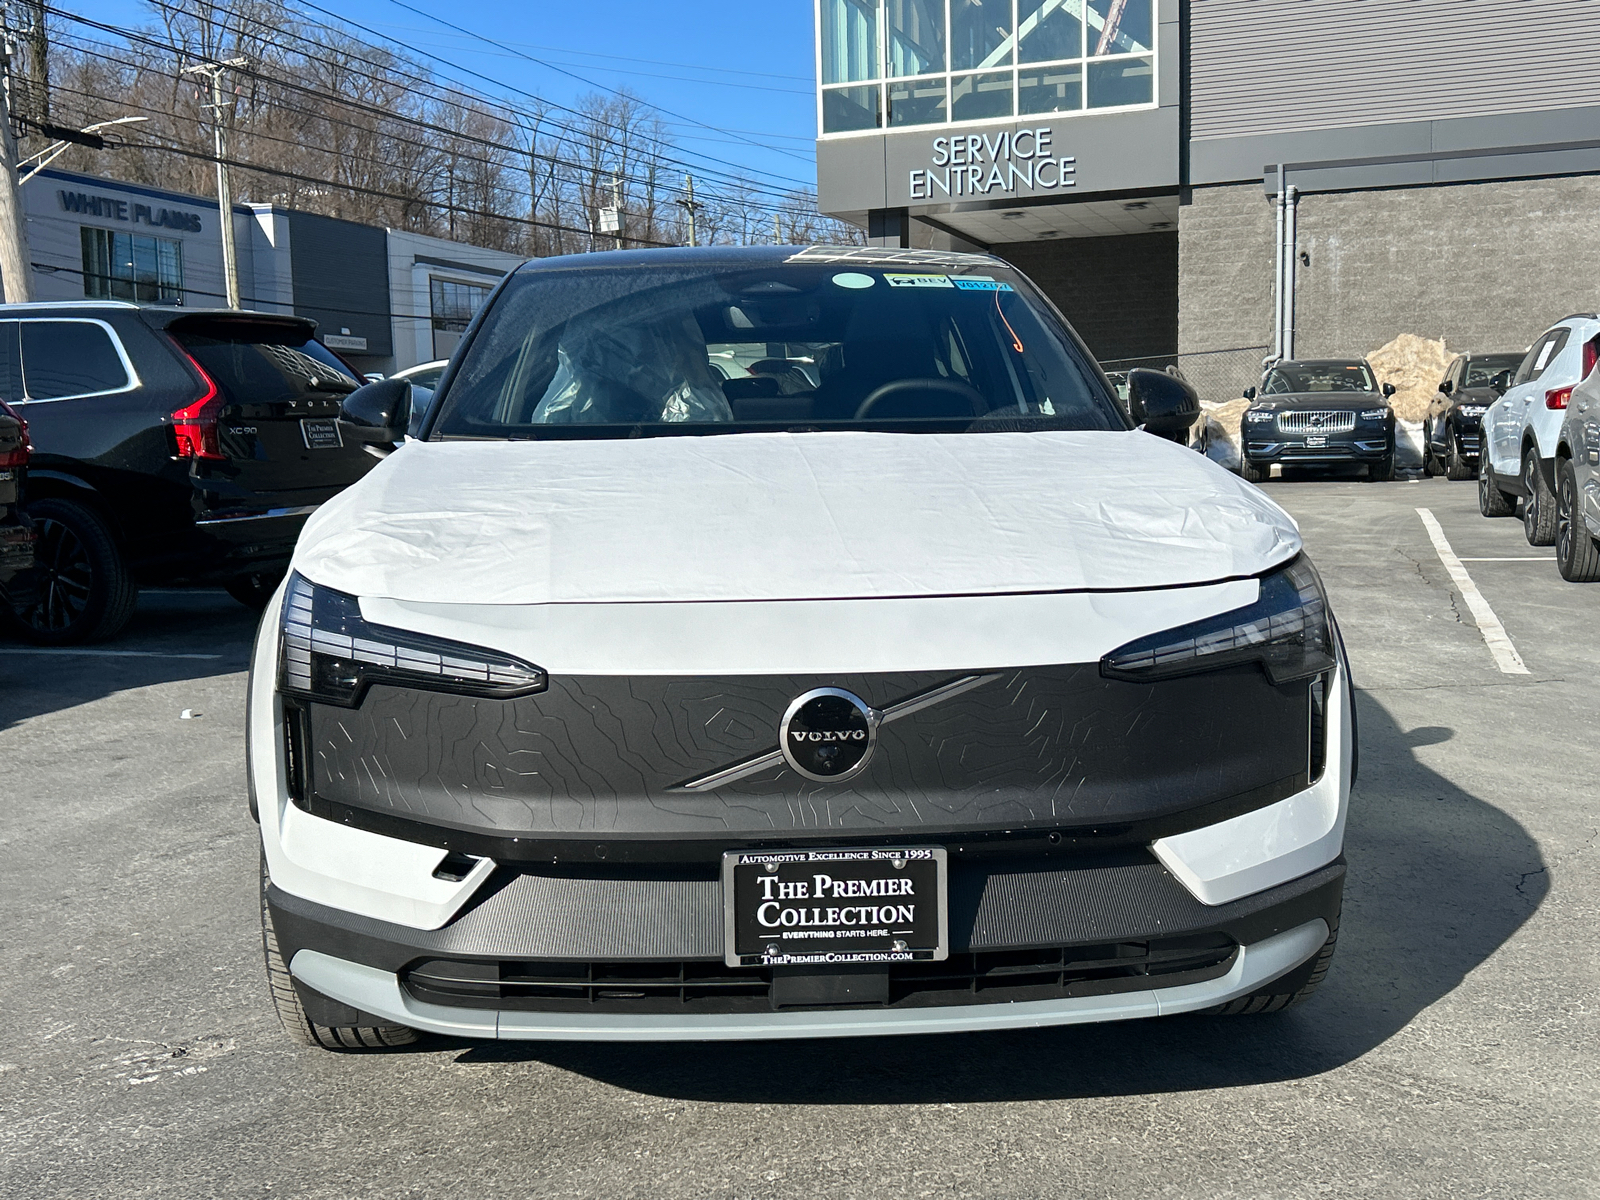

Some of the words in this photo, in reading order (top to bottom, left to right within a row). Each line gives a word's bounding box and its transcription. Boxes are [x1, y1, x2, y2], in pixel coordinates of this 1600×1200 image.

[932, 127, 1052, 167] SERVICE
[909, 157, 1076, 199] ENTRANCE
[58, 190, 129, 221] WHITE
[132, 203, 202, 233] PLAINS
[288, 400, 342, 408] VOLV
[229, 426, 258, 435] XC90
[791, 729, 866, 742] VOLVO
[740, 854, 806, 863] AUTOMOTIVE
[808, 851, 869, 861] EXCELLENCE
[871, 850, 901, 860] SINCE
[903, 849, 932, 859] 1995
[756, 875, 809, 900] THE
[813, 874, 915, 899] PREMIER
[756, 901, 915, 927] COLLECTION
[782, 931, 835, 939] EVERYTHING
[836, 930, 866, 938] STARTS
[866, 929, 890, 937] HERE.
